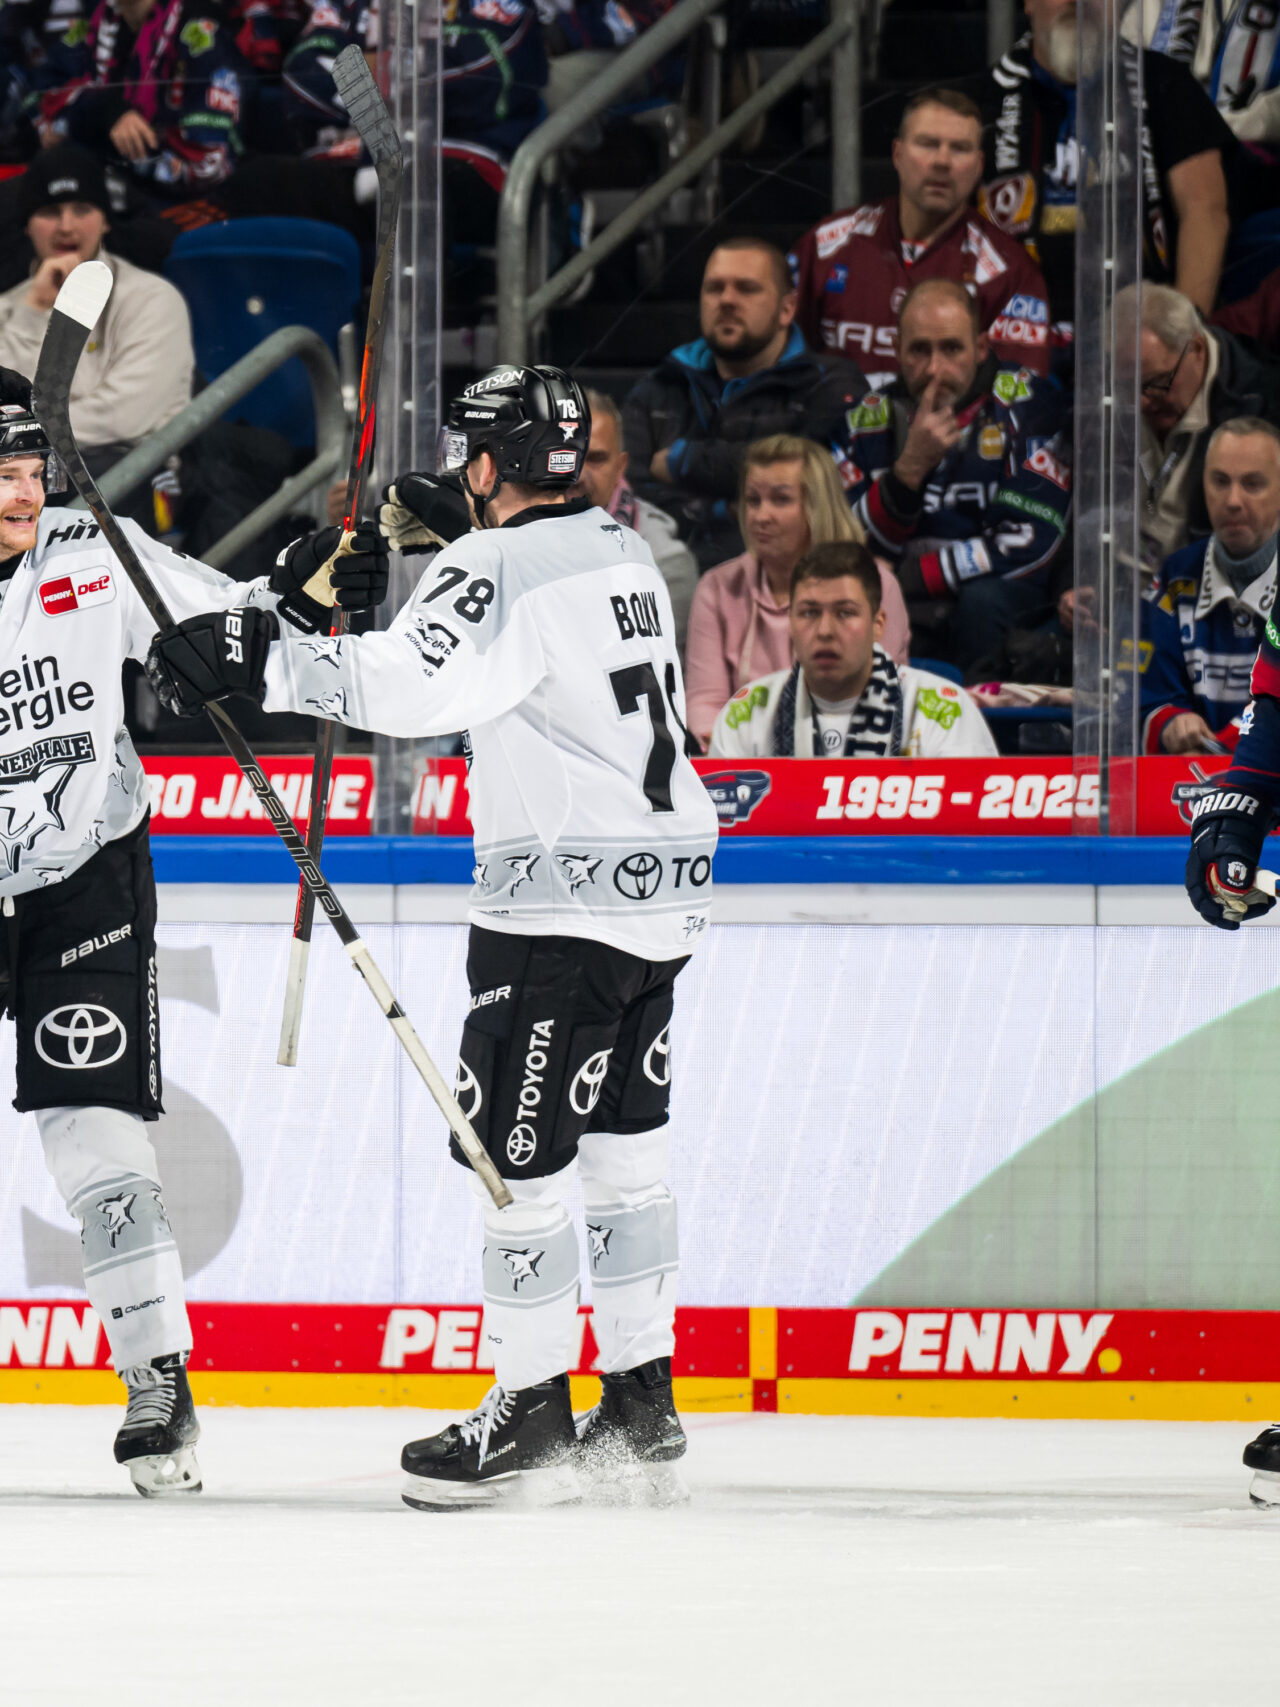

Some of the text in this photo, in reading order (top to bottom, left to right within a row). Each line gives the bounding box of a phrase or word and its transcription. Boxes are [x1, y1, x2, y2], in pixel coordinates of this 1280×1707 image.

[462, 370, 525, 400] STETSON
[464, 411, 496, 420] BAUER
[557, 399, 579, 419] 78
[421, 566, 495, 624] 78
[35, 735, 92, 761] HAIE
[816, 774, 946, 820] 1995
[978, 773, 1101, 819] 2025
[61, 923, 132, 968] BAUER
[516, 1019, 555, 1121] TOYOTA
[481, 1440, 517, 1464] AUER
